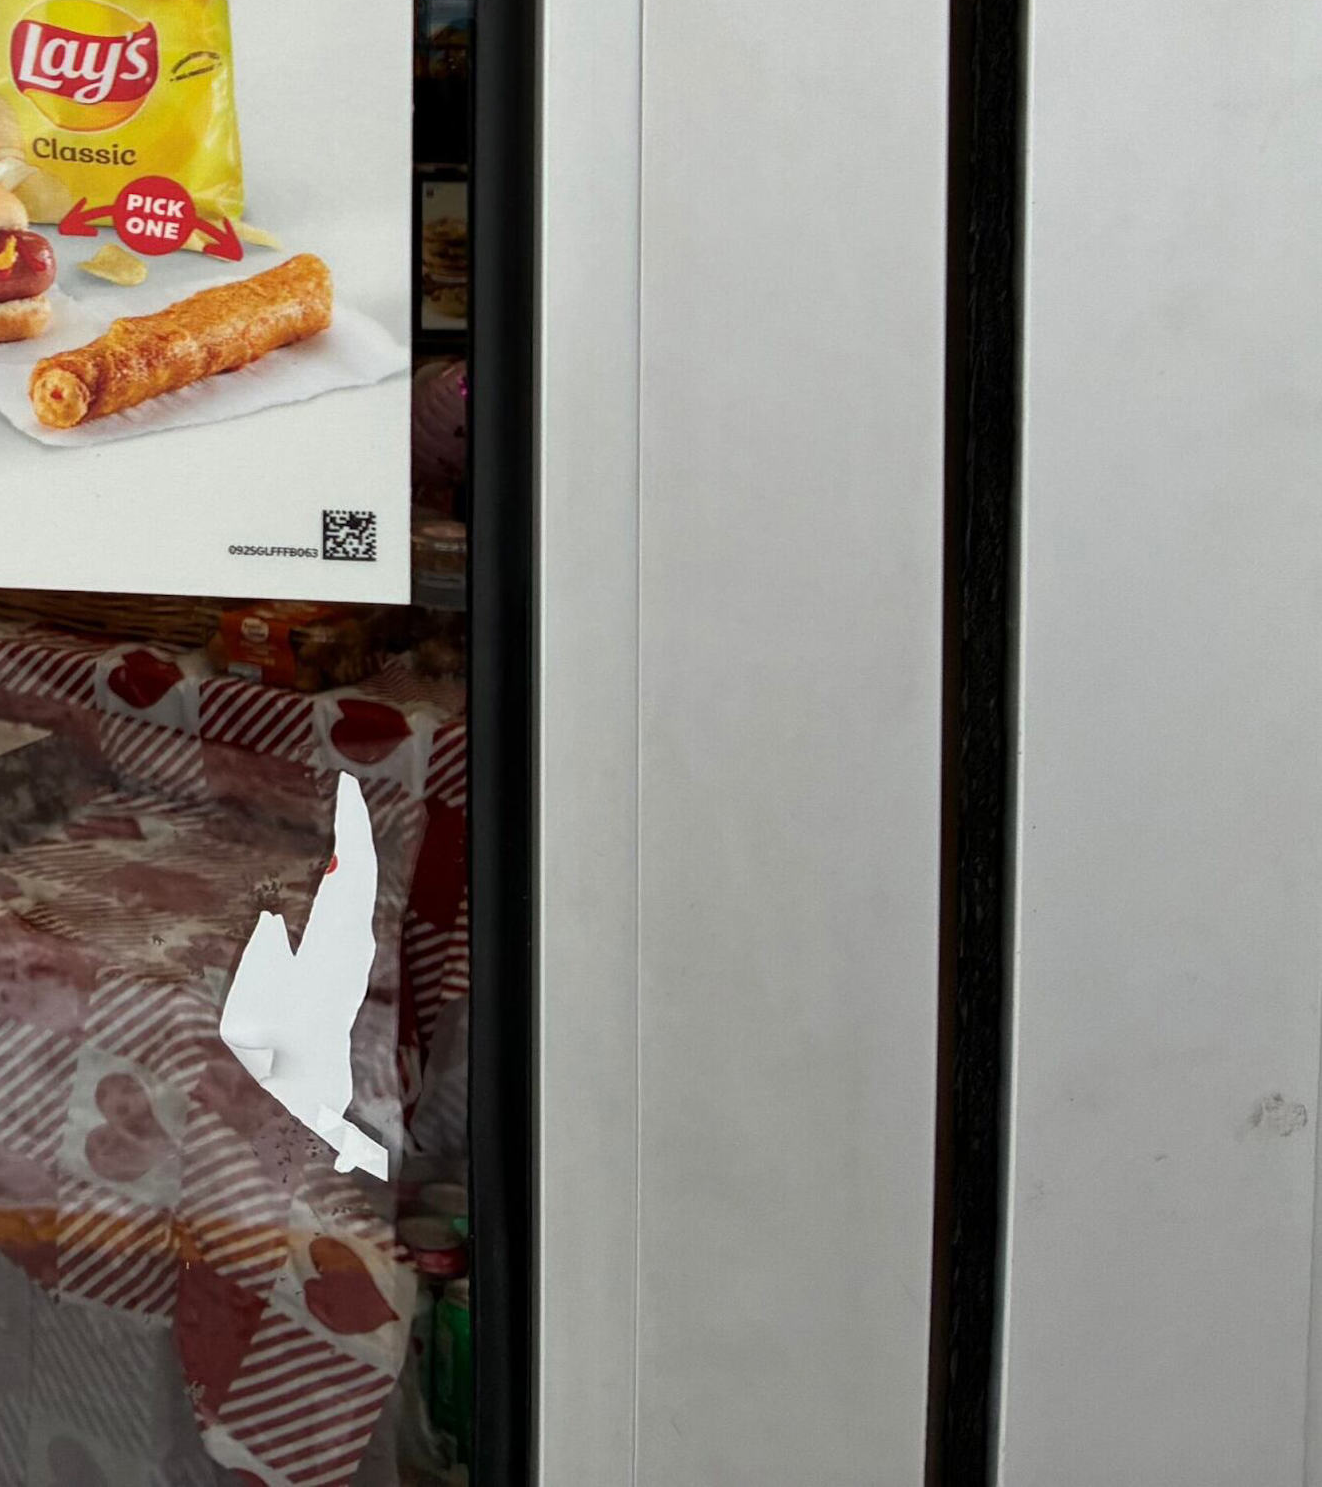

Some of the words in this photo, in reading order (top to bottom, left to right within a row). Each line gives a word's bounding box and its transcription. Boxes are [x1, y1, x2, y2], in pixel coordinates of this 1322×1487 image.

[19, 23, 152, 105] Lay's
[32, 137, 137, 166] Classic
[126, 193, 186, 218] PICK
[125, 217, 180, 240] ONE
